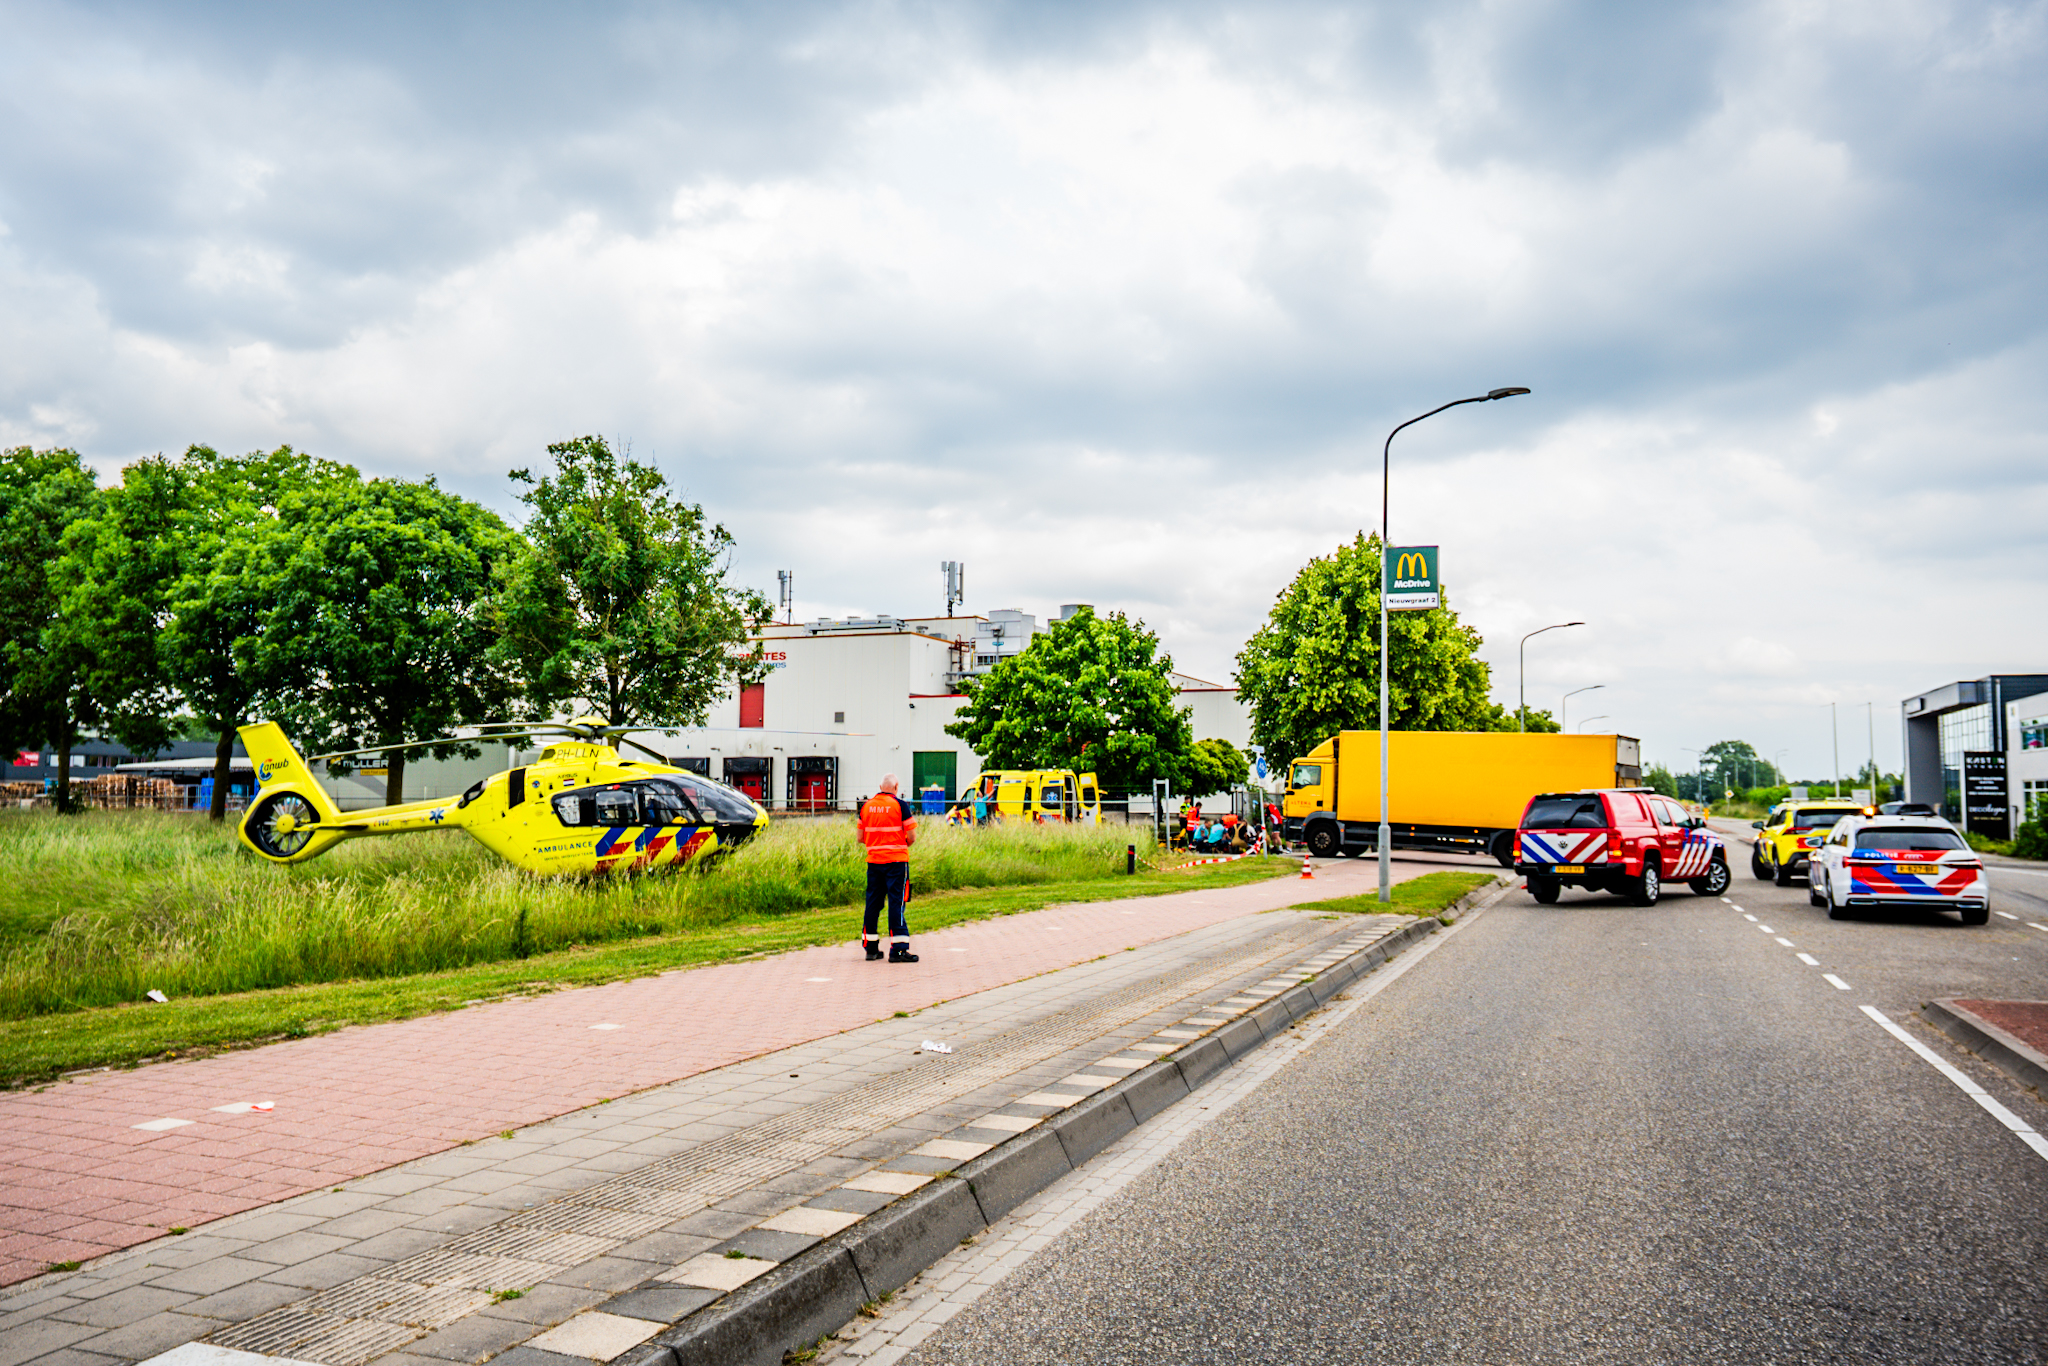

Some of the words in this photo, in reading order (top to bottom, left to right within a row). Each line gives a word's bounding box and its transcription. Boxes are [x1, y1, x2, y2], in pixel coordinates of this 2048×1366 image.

[1394, 580, 1430, 588] McDrive
[557, 748, 599, 758] PH-LLN
[264, 758, 288, 770] anwb
[538, 841, 593, 853] AMBULANCE
